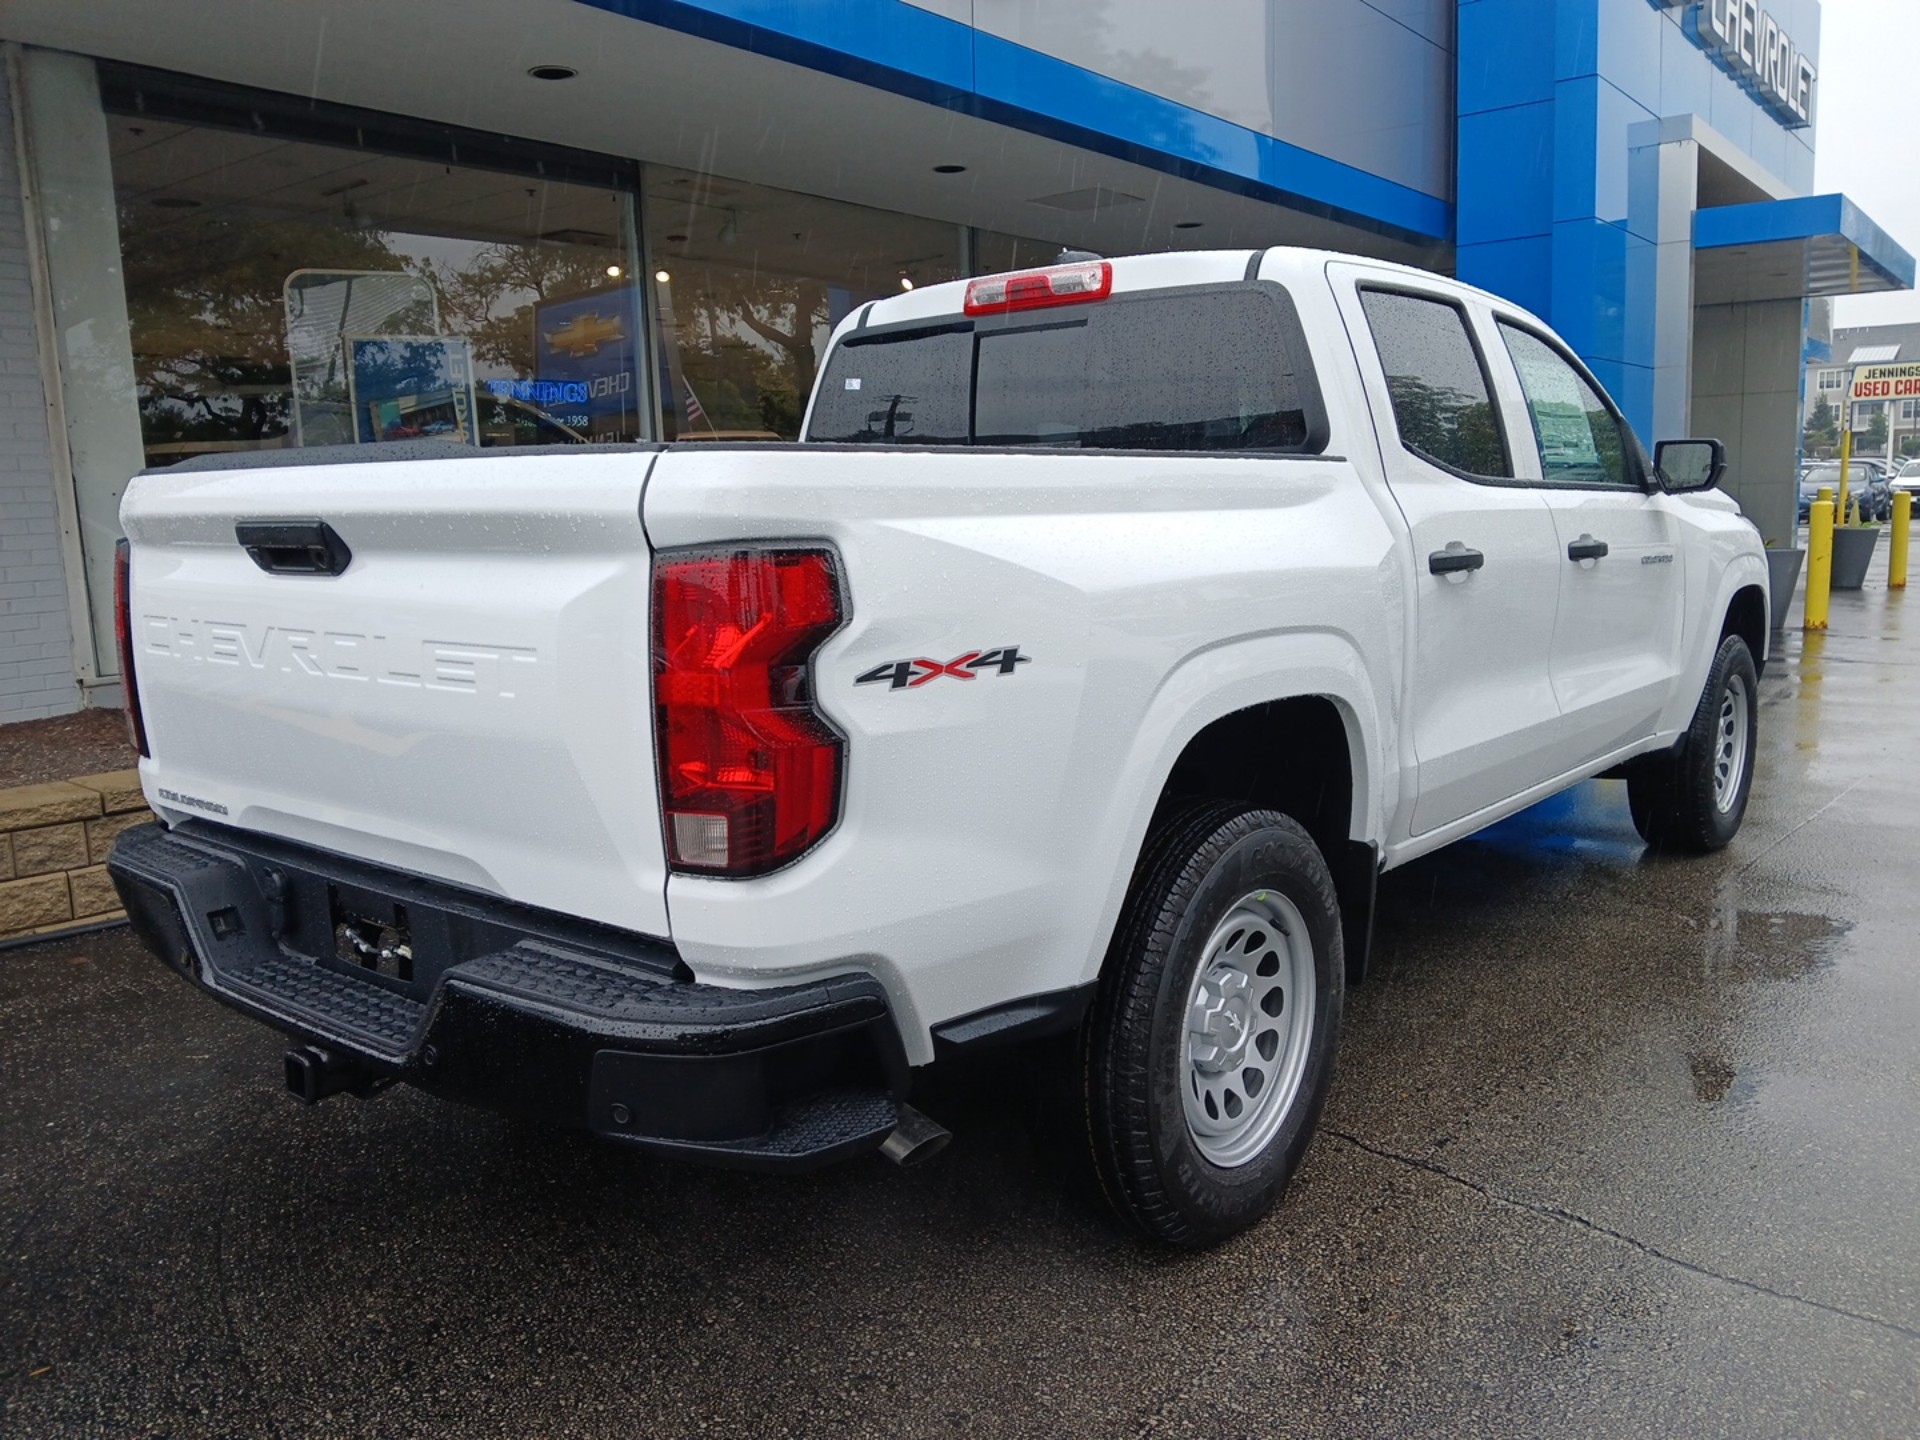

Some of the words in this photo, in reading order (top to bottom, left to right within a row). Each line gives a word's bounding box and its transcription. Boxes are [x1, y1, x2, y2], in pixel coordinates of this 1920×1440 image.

[1864, 366, 1920, 379] JENNINGS
[487, 380, 589, 403] JENNINGS
[1854, 380, 1890, 397] USED
[566, 415, 589, 427] 1958
[144, 614, 537, 698] CHEVROLET
